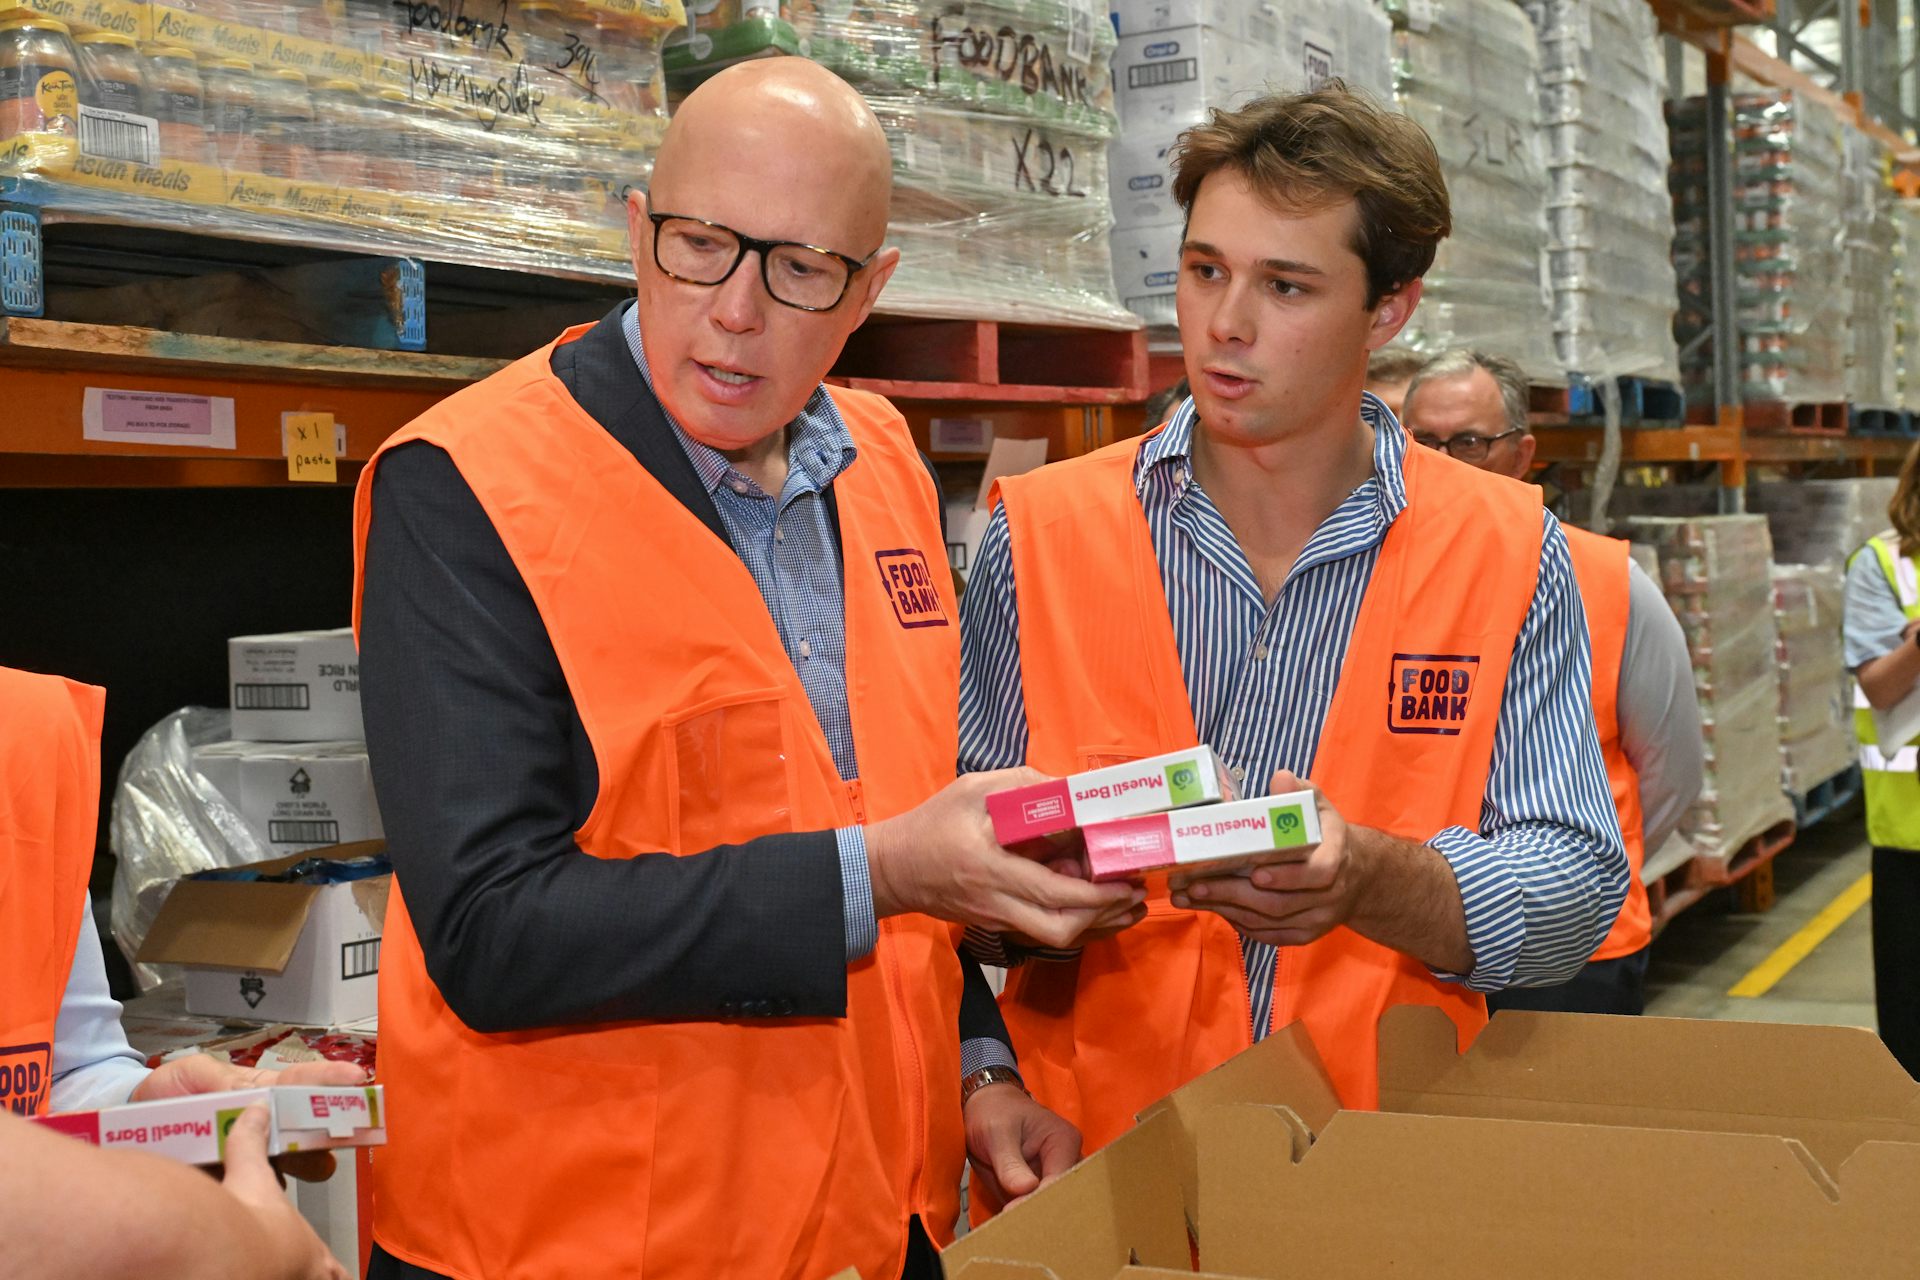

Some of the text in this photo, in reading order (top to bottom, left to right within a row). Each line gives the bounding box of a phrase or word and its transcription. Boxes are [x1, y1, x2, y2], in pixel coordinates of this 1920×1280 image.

[22, 0, 137, 33] sian Meals
[271, 40, 314, 66] Asian
[0, 144, 29, 161] als
[72, 157, 191, 191] Asian Meals
[296, 454, 331, 474] pasta
[888, 562, 929, 588] FOOD
[897, 588, 940, 615] BANK
[333, 679, 359, 692] RLD
[1402, 668, 1470, 694] FOOD
[1400, 695, 1468, 721] BANK
[1075, 774, 1163, 801] Muesli Bars
[1176, 816, 1267, 838] Muesli Bars
[0, 1061, 40, 1098] OOD
[106, 1120, 211, 1143] Muesli Bars
